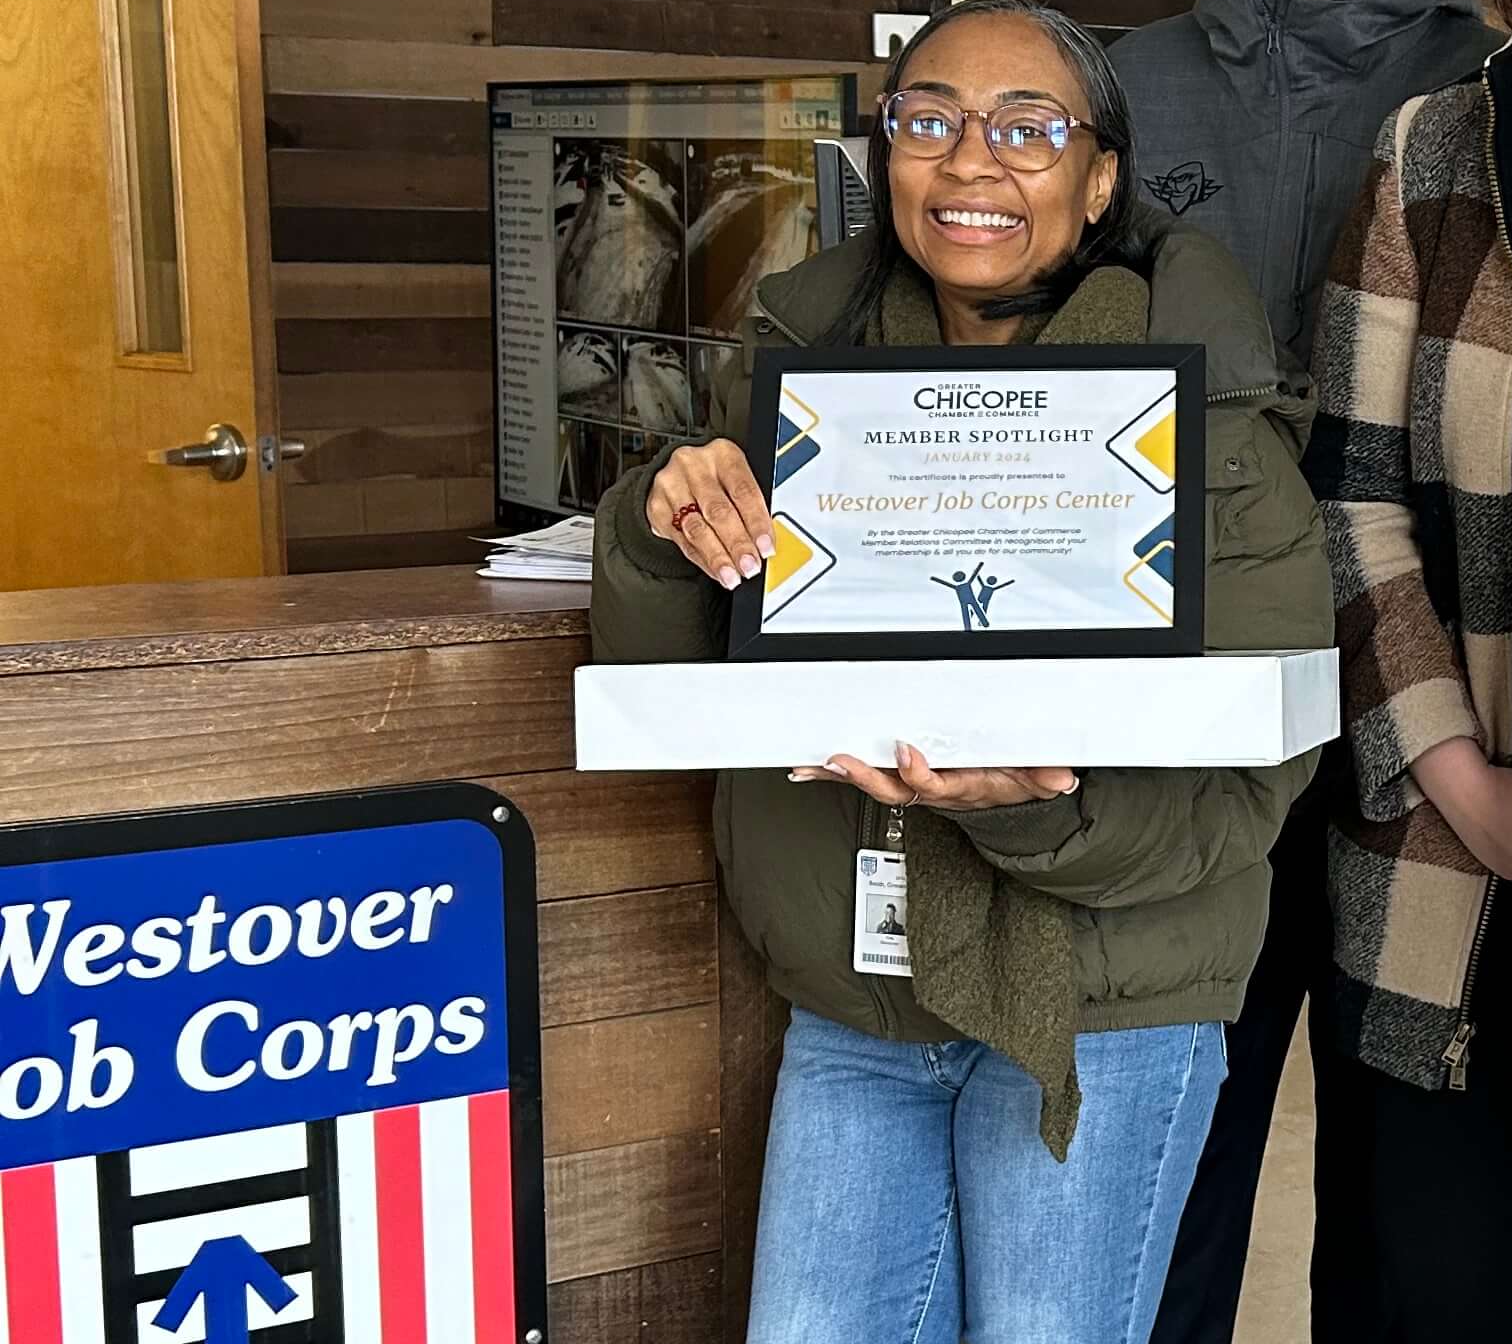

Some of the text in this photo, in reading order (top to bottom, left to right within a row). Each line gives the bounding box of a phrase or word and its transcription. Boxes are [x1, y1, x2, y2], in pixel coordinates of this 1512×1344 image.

[913, 387, 1049, 410] CHICOPEE
[863, 429, 1094, 444] MEMBER SPOTLIGHT
[923, 451, 991, 464] JANUARY
[909, 473, 956, 481] certificate
[969, 473, 1003, 482] proudly
[1006, 472, 1053, 481] presented
[816, 490, 1135, 515] Westover Job Corps Center
[932, 528, 975, 537] Chicopee
[976, 527, 1019, 535] Chamber
[1021, 527, 1031, 535] of
[1032, 527, 1082, 535] Commerce
[899, 538, 940, 546] Relations
[942, 538, 992, 546] Committee
[1004, 537, 1054, 546] recognition
[1056, 537, 1066, 545] of
[875, 548, 932, 557] membership
[955, 548, 972, 556] you
[988, 547, 1001, 555] for
[0, 881, 452, 997] Westover
[0, 994, 487, 1121] ob Corps
